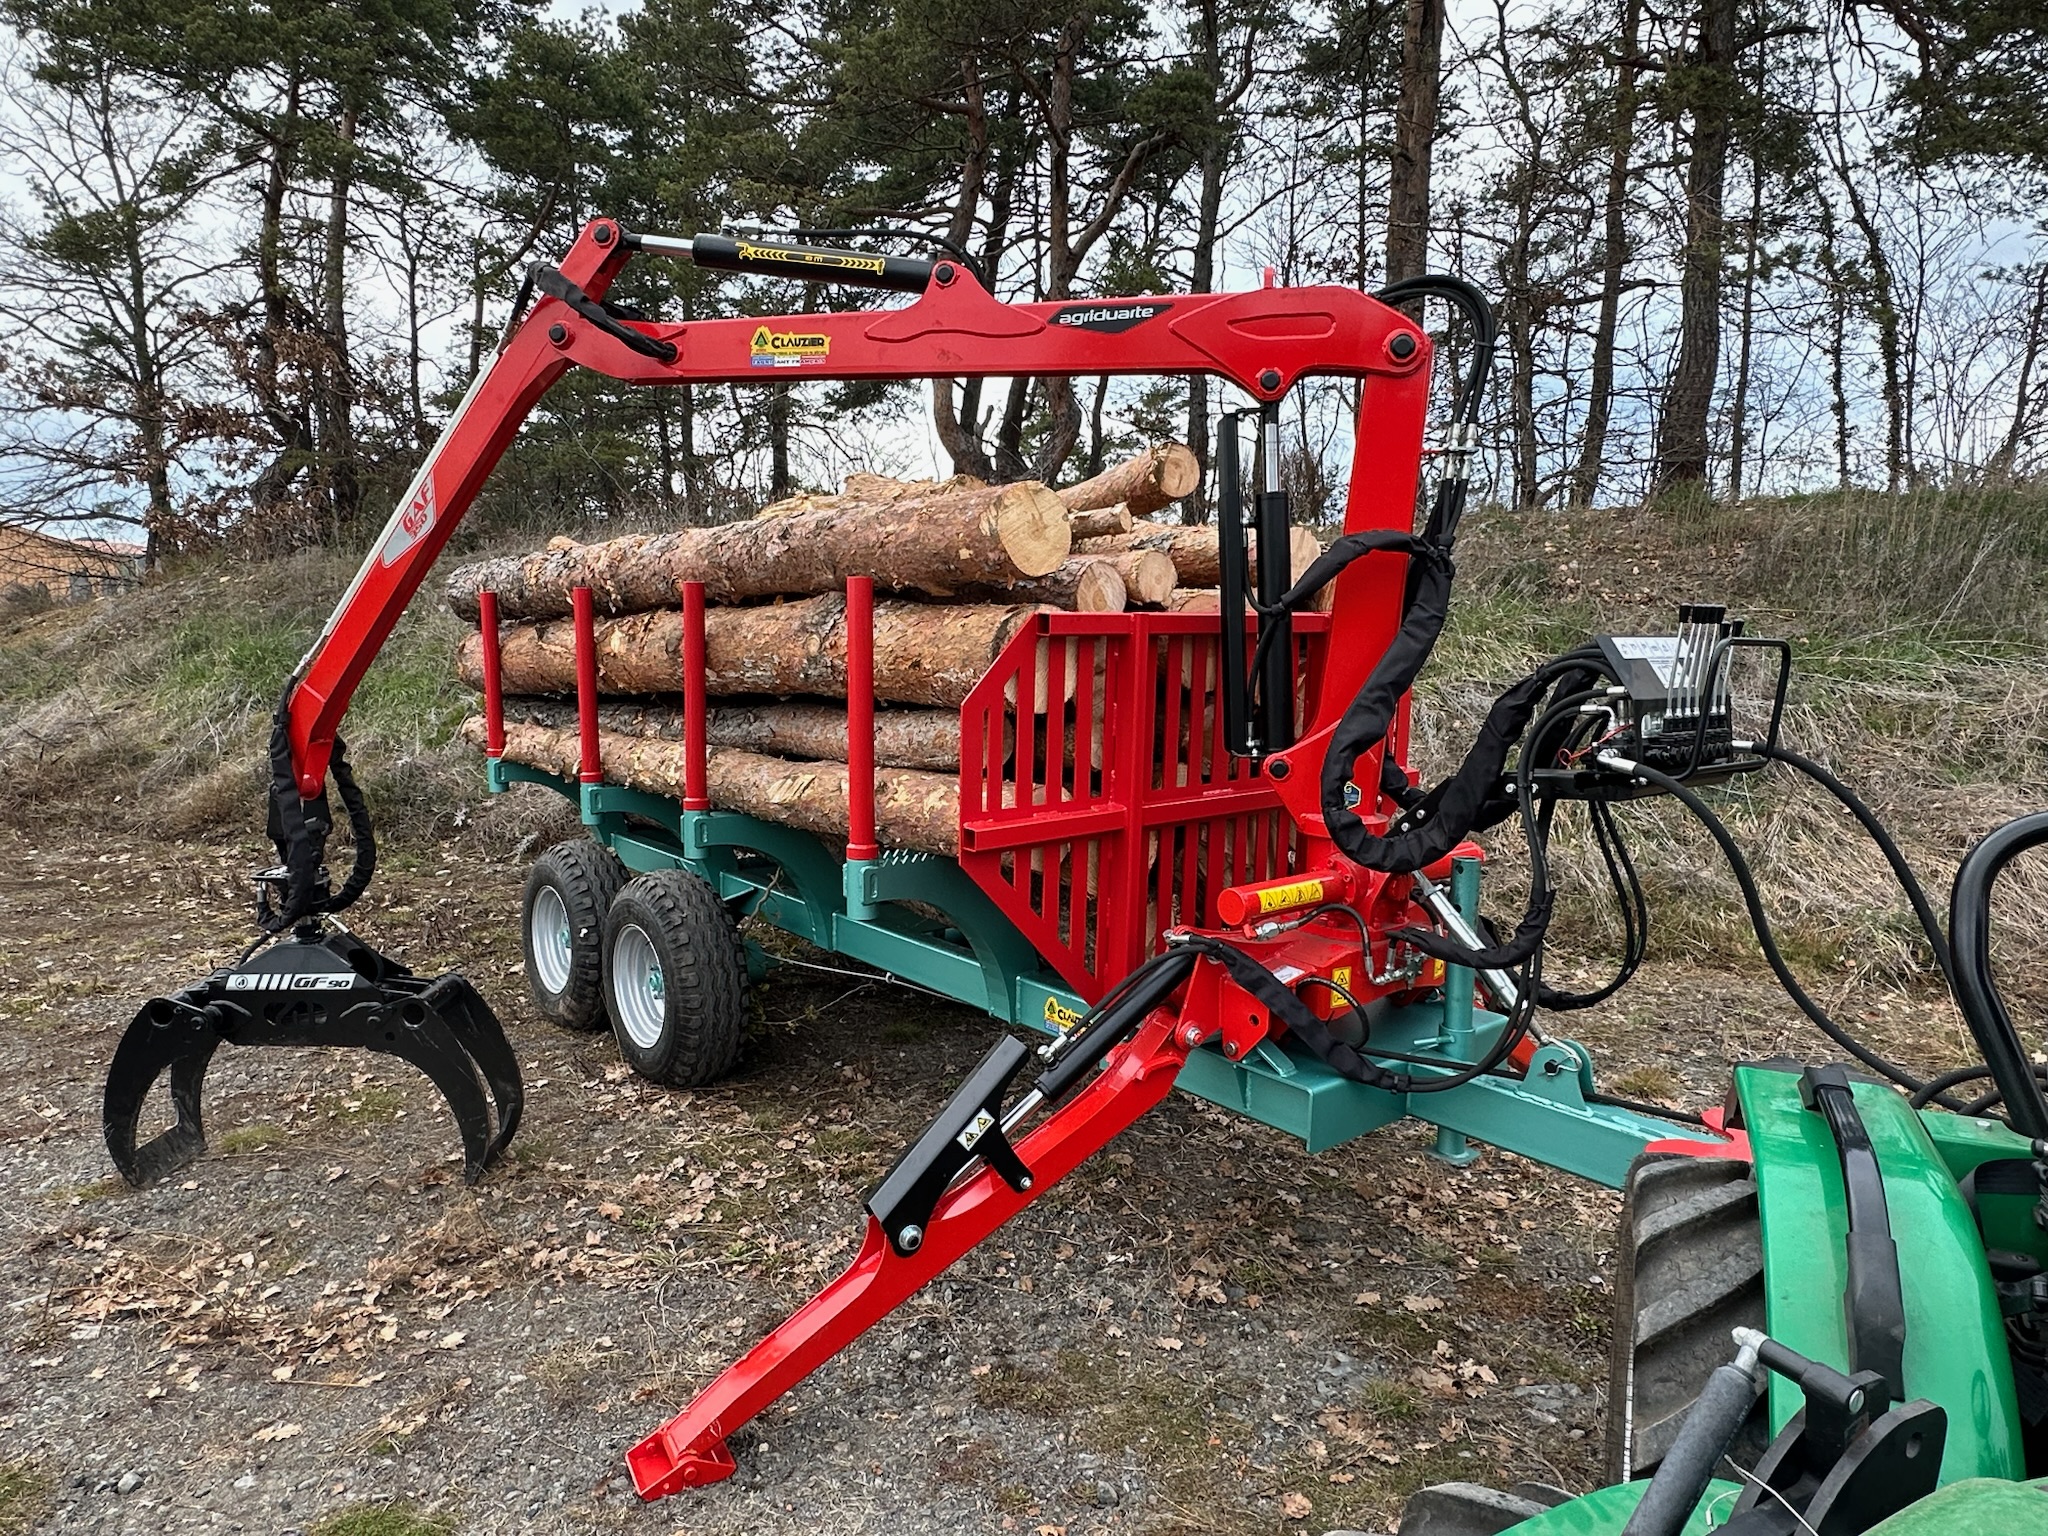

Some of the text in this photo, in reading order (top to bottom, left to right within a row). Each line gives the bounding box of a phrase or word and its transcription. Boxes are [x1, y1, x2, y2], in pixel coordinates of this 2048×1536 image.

[1059, 306, 1153, 325] agriduarte
[771, 336, 825, 349] CLAUZIER
[403, 483, 430, 533] GAF
[294, 977, 350, 988] GF 90
